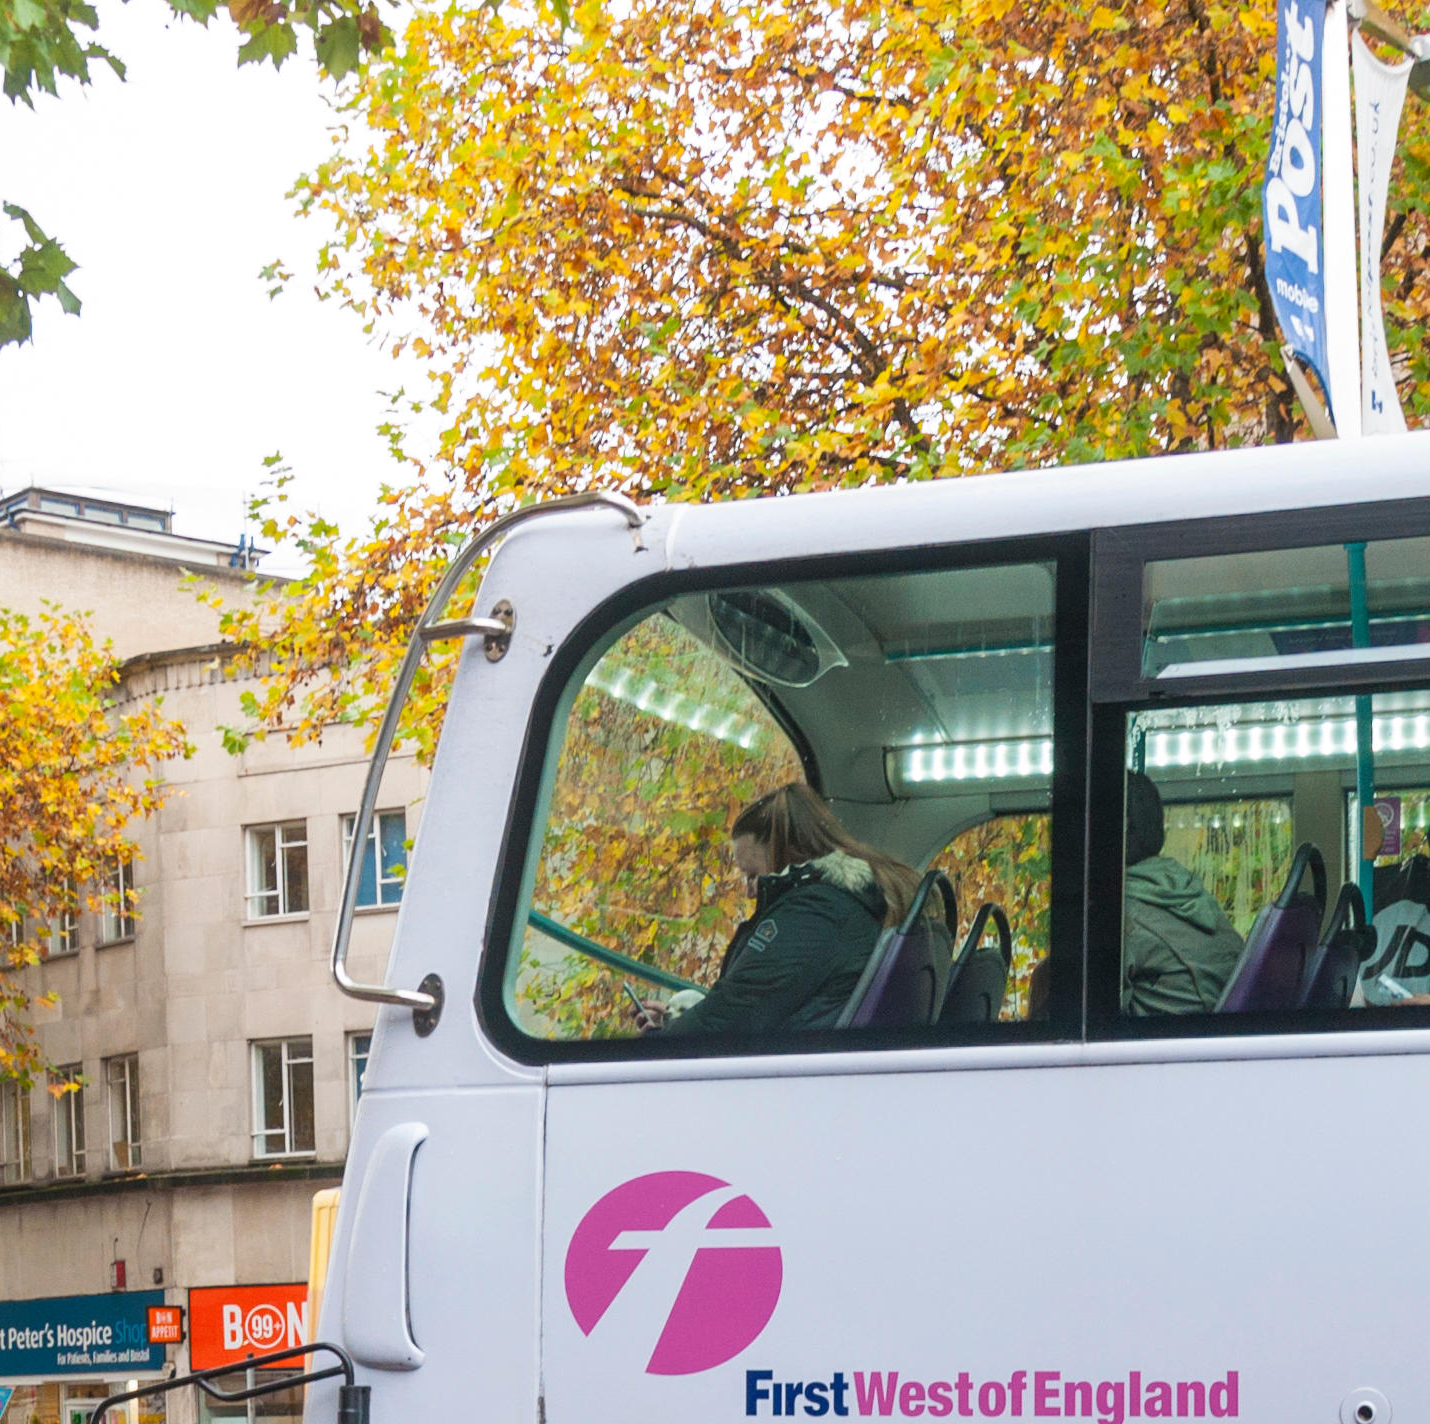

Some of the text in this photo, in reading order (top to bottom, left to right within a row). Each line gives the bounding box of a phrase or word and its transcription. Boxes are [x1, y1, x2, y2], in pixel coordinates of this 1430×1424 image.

[1267, 0, 1319, 274] Post
[8, 1322, 54, 1350] Peter's
[57, 1320, 112, 1351] Hospice
[152, 1325, 179, 1339] APPETIT
[93, 1350, 117, 1363] Families
[118, 1349, 130, 1362] and
[131, 1348, 150, 1362] Bristol
[746, 1370, 849, 1417] First
[854, 1371, 972, 1417] West
[979, 1370, 1027, 1417] of
